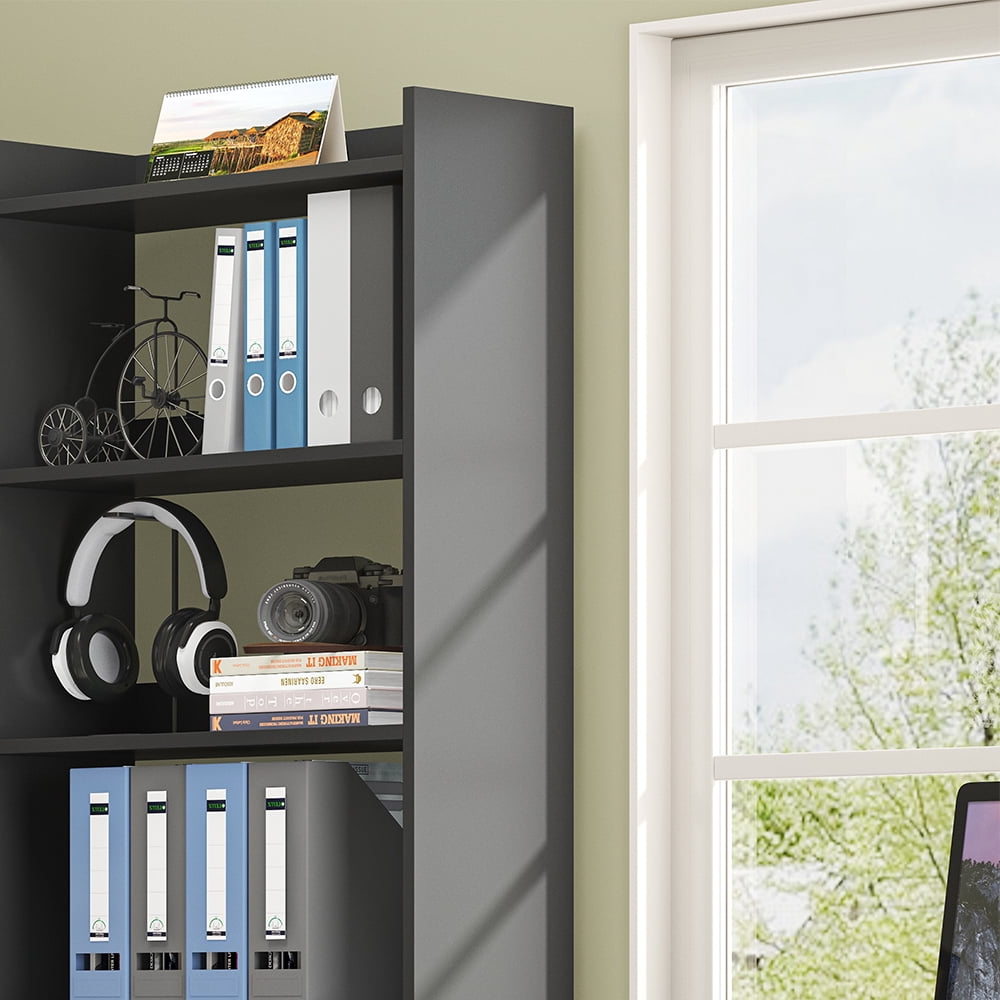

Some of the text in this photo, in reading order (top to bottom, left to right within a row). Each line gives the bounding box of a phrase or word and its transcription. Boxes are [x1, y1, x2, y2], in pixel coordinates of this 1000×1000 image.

[306, 657, 316, 668] IT
[317, 655, 357, 667] MAKING
[280, 676, 325, 686] EERO SAARINEN
[308, 714, 318, 726] IT
[320, 712, 361, 725] MAKING
